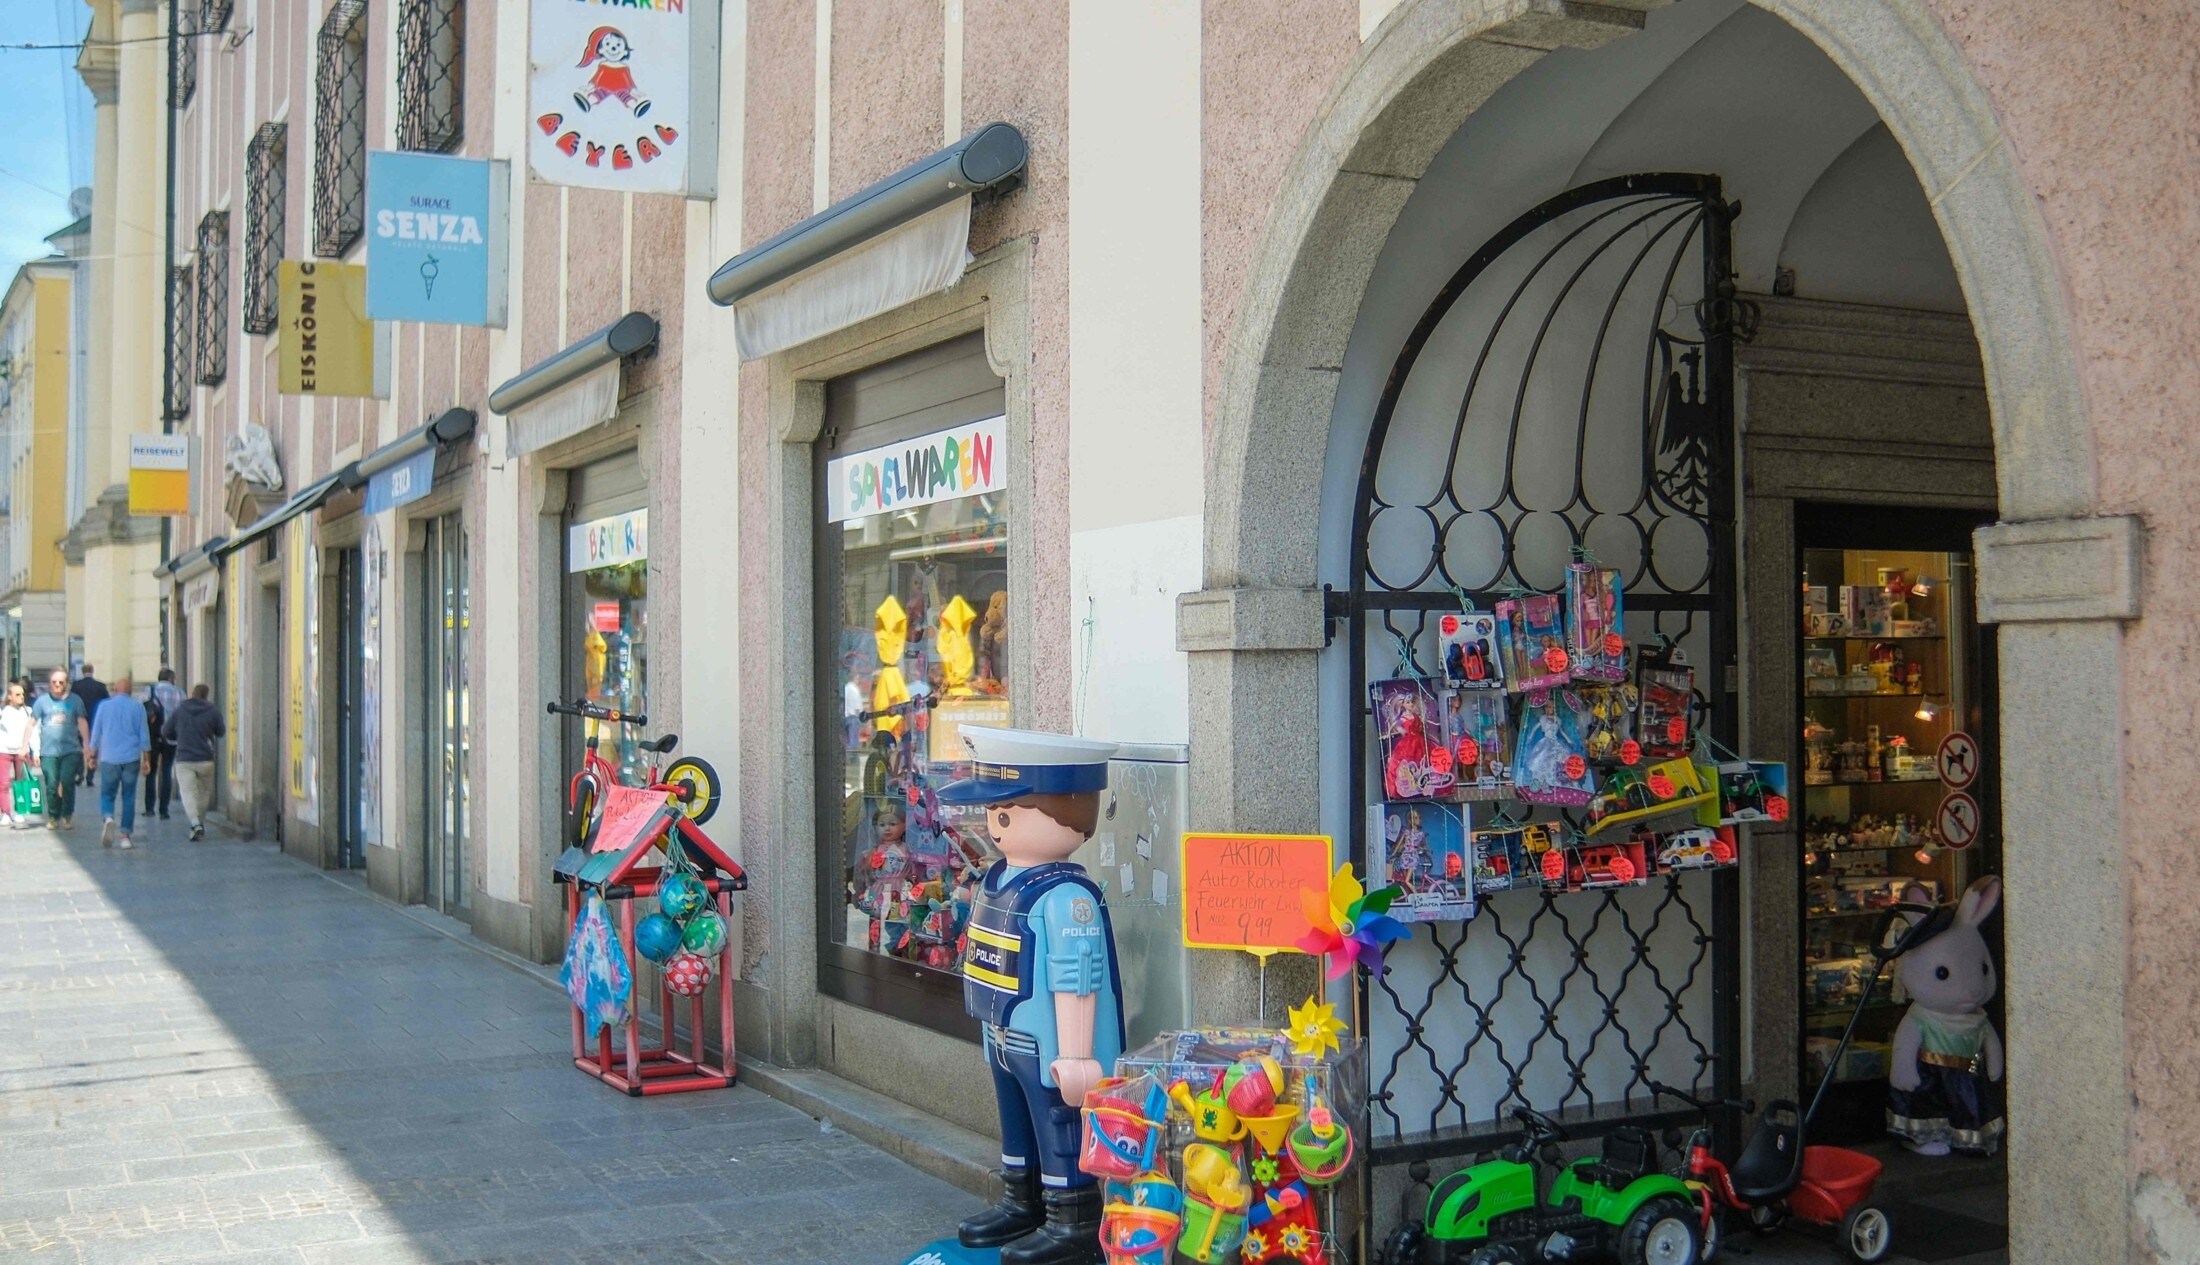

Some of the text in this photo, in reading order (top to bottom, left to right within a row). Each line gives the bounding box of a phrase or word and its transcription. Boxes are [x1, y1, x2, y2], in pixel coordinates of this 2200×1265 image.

[536, 112, 679, 171] BEYERL
[410, 196, 452, 210] SURACE
[377, 208, 484, 245] SENZA
[133, 446, 185, 457] REISEWELT
[849, 431, 993, 512] SPIELWAREN
[588, 516, 642, 562] BEYERL
[1219, 841, 1282, 868] AKTION
[1062, 926, 1101, 938] POLICE
[975, 948, 1002, 967] POLICE
